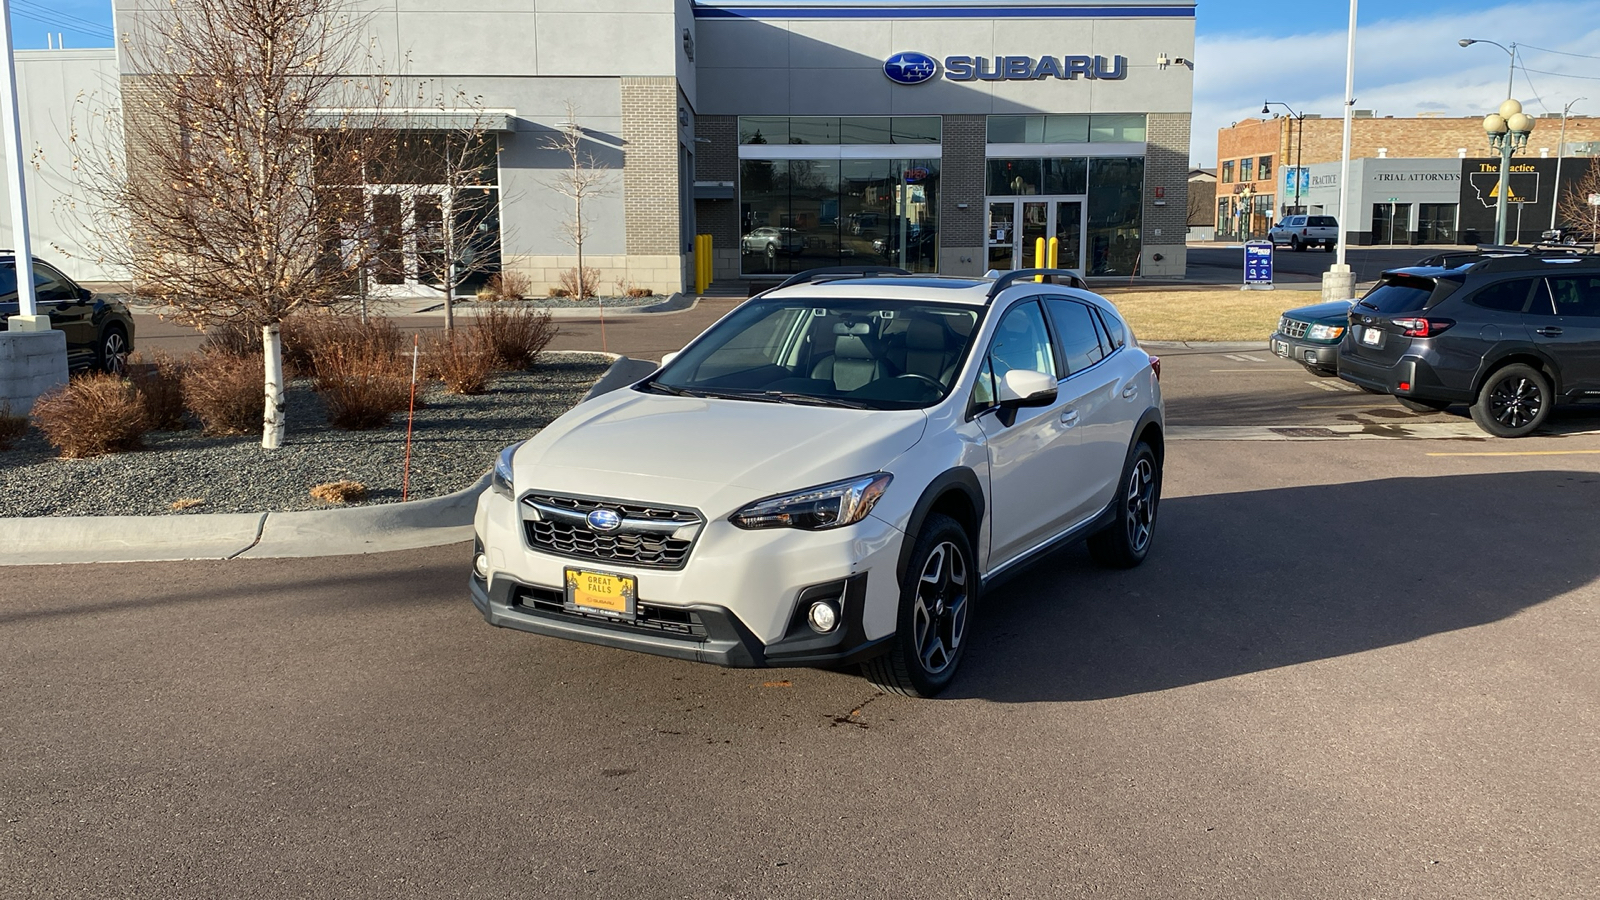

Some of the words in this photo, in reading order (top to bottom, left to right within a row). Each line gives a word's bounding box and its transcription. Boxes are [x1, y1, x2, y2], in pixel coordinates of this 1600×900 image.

[944, 54, 1122, 79] SUBARU
[1479, 163, 1497, 172] The
[1500, 163, 1535, 172] actice
[1312, 174, 1337, 185] PRACTICE
[1378, 173, 1406, 181] TRIAL
[1408, 173, 1460, 181] ATTORNEYS
[588, 576, 612, 585] GREAT
[588, 584, 612, 594] FALLS
